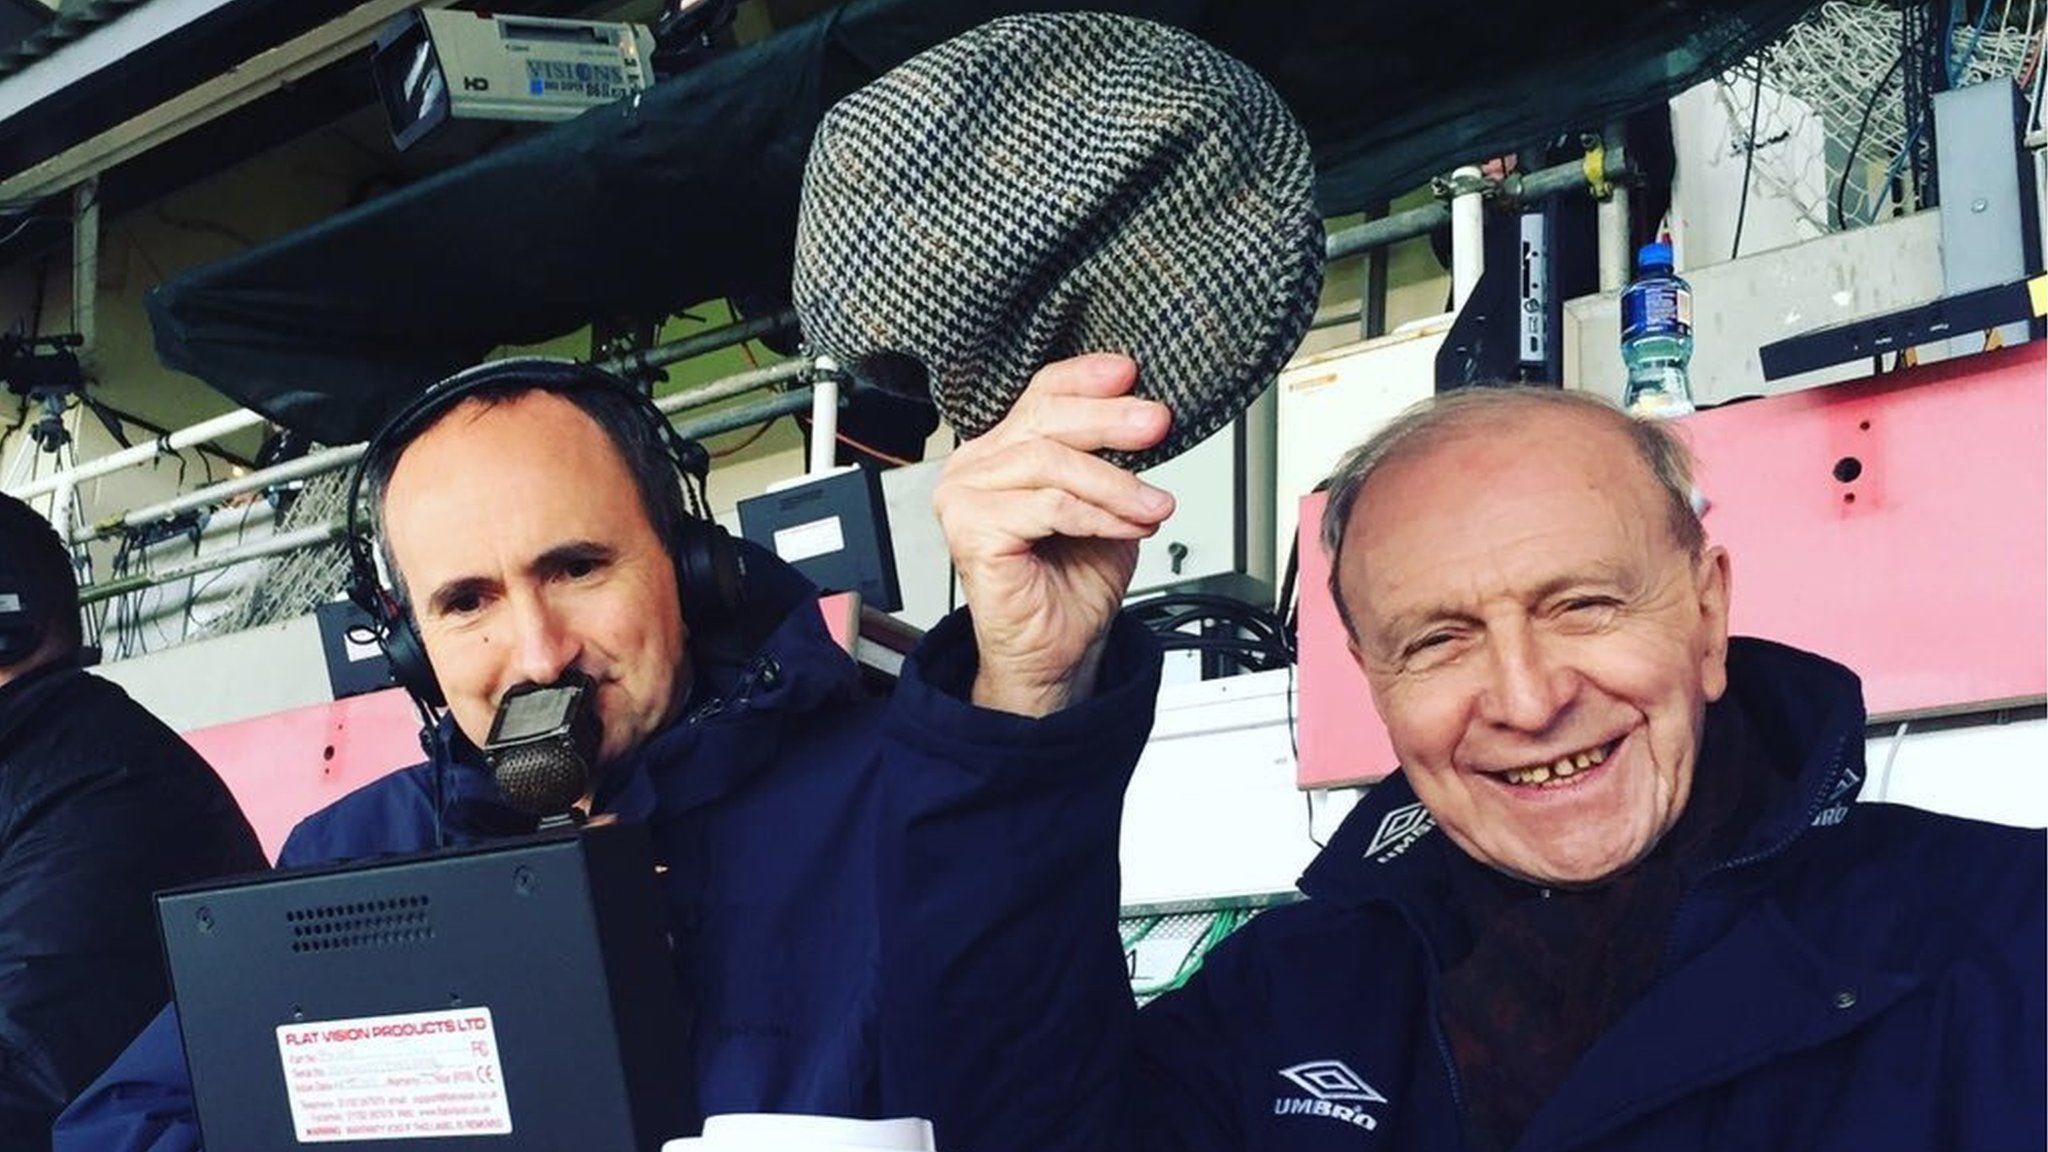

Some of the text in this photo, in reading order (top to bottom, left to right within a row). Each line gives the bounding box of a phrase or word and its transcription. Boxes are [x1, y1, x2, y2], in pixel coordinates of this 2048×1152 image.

[464, 76, 489, 91] HD
[526, 60, 624, 84] VISIONS
[286, 1017, 487, 1046] FLAT VISION PRODUCTS LTD
[1274, 1098, 1378, 1131] UMBRO
